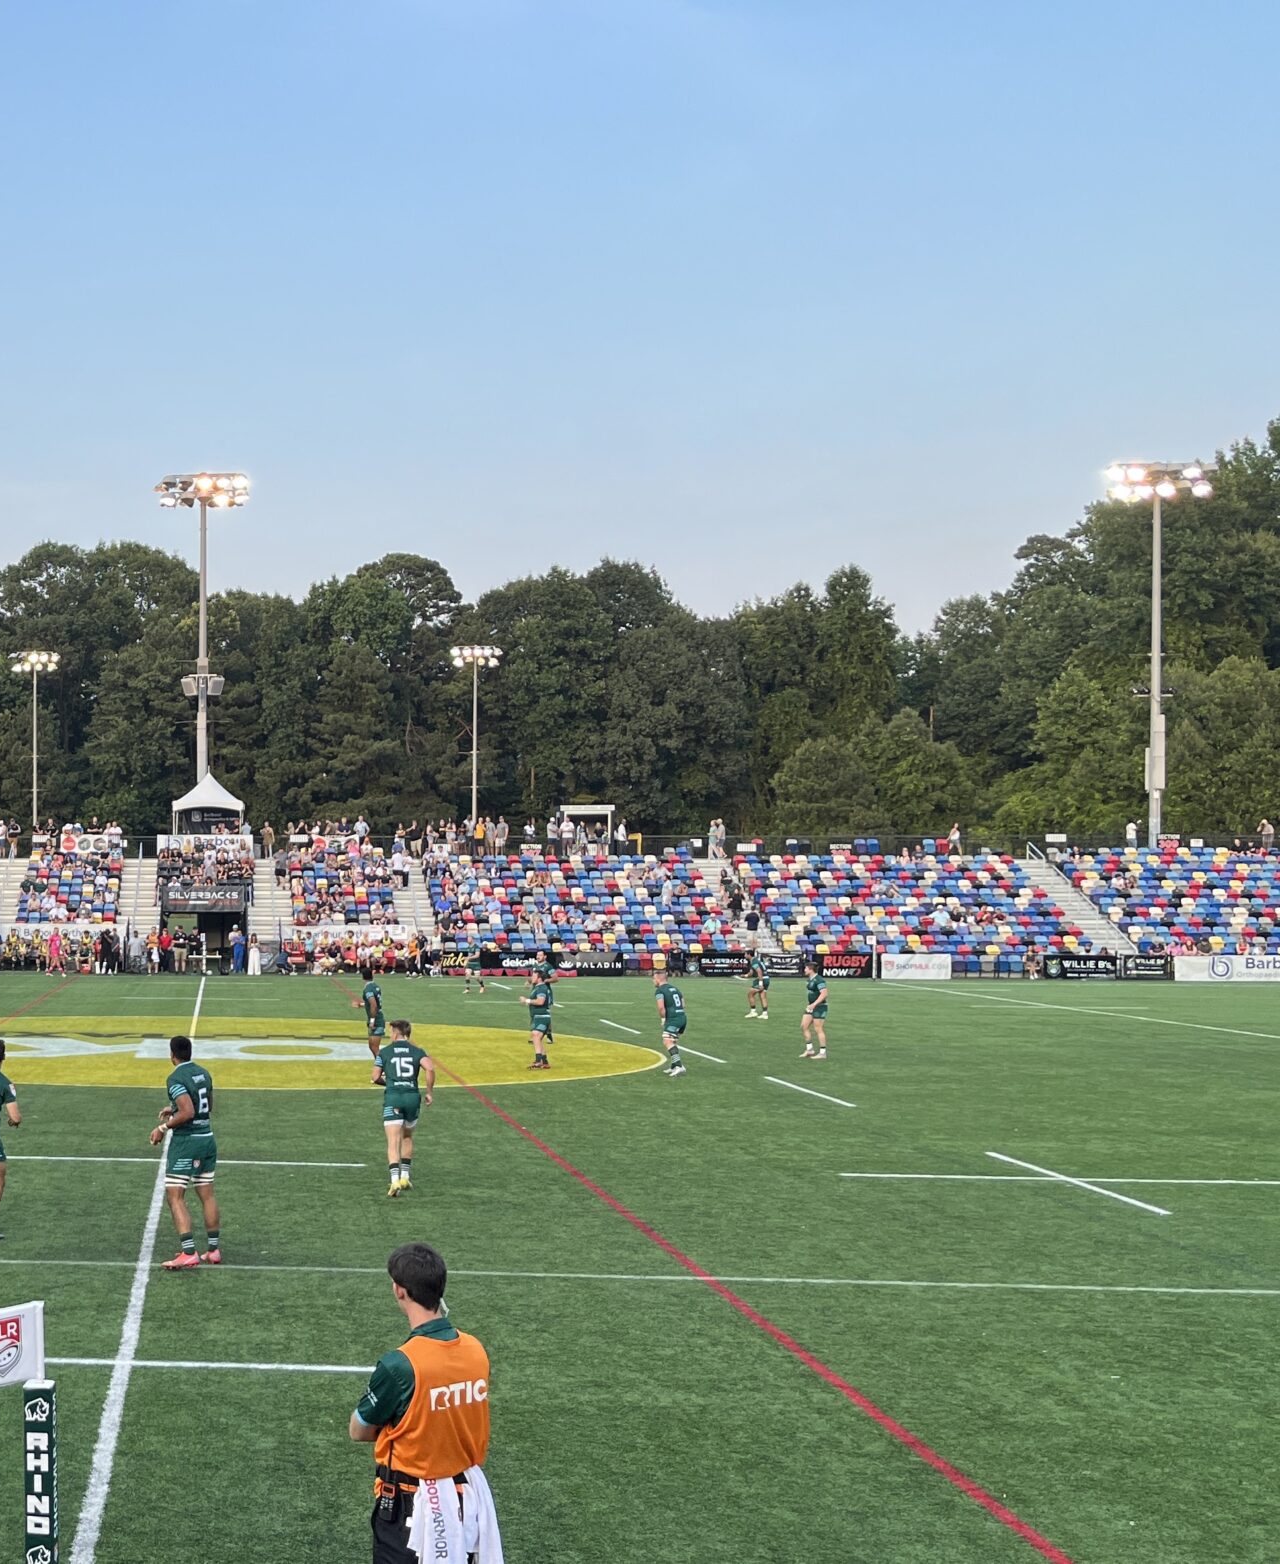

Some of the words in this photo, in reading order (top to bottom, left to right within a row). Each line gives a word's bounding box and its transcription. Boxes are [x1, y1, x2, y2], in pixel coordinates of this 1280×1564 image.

[168, 891, 239, 899] SILVERBACKS
[823, 956, 870, 967] RUGBY
[1062, 960, 1095, 968] WILLIE
[823, 968, 848, 976] NOW
[390, 1056, 414, 1078] 15
[429, 1378, 488, 1412] RTIC
[25, 1431, 51, 1535] RHINO
[424, 1478, 449, 1560] BODYARMOR
